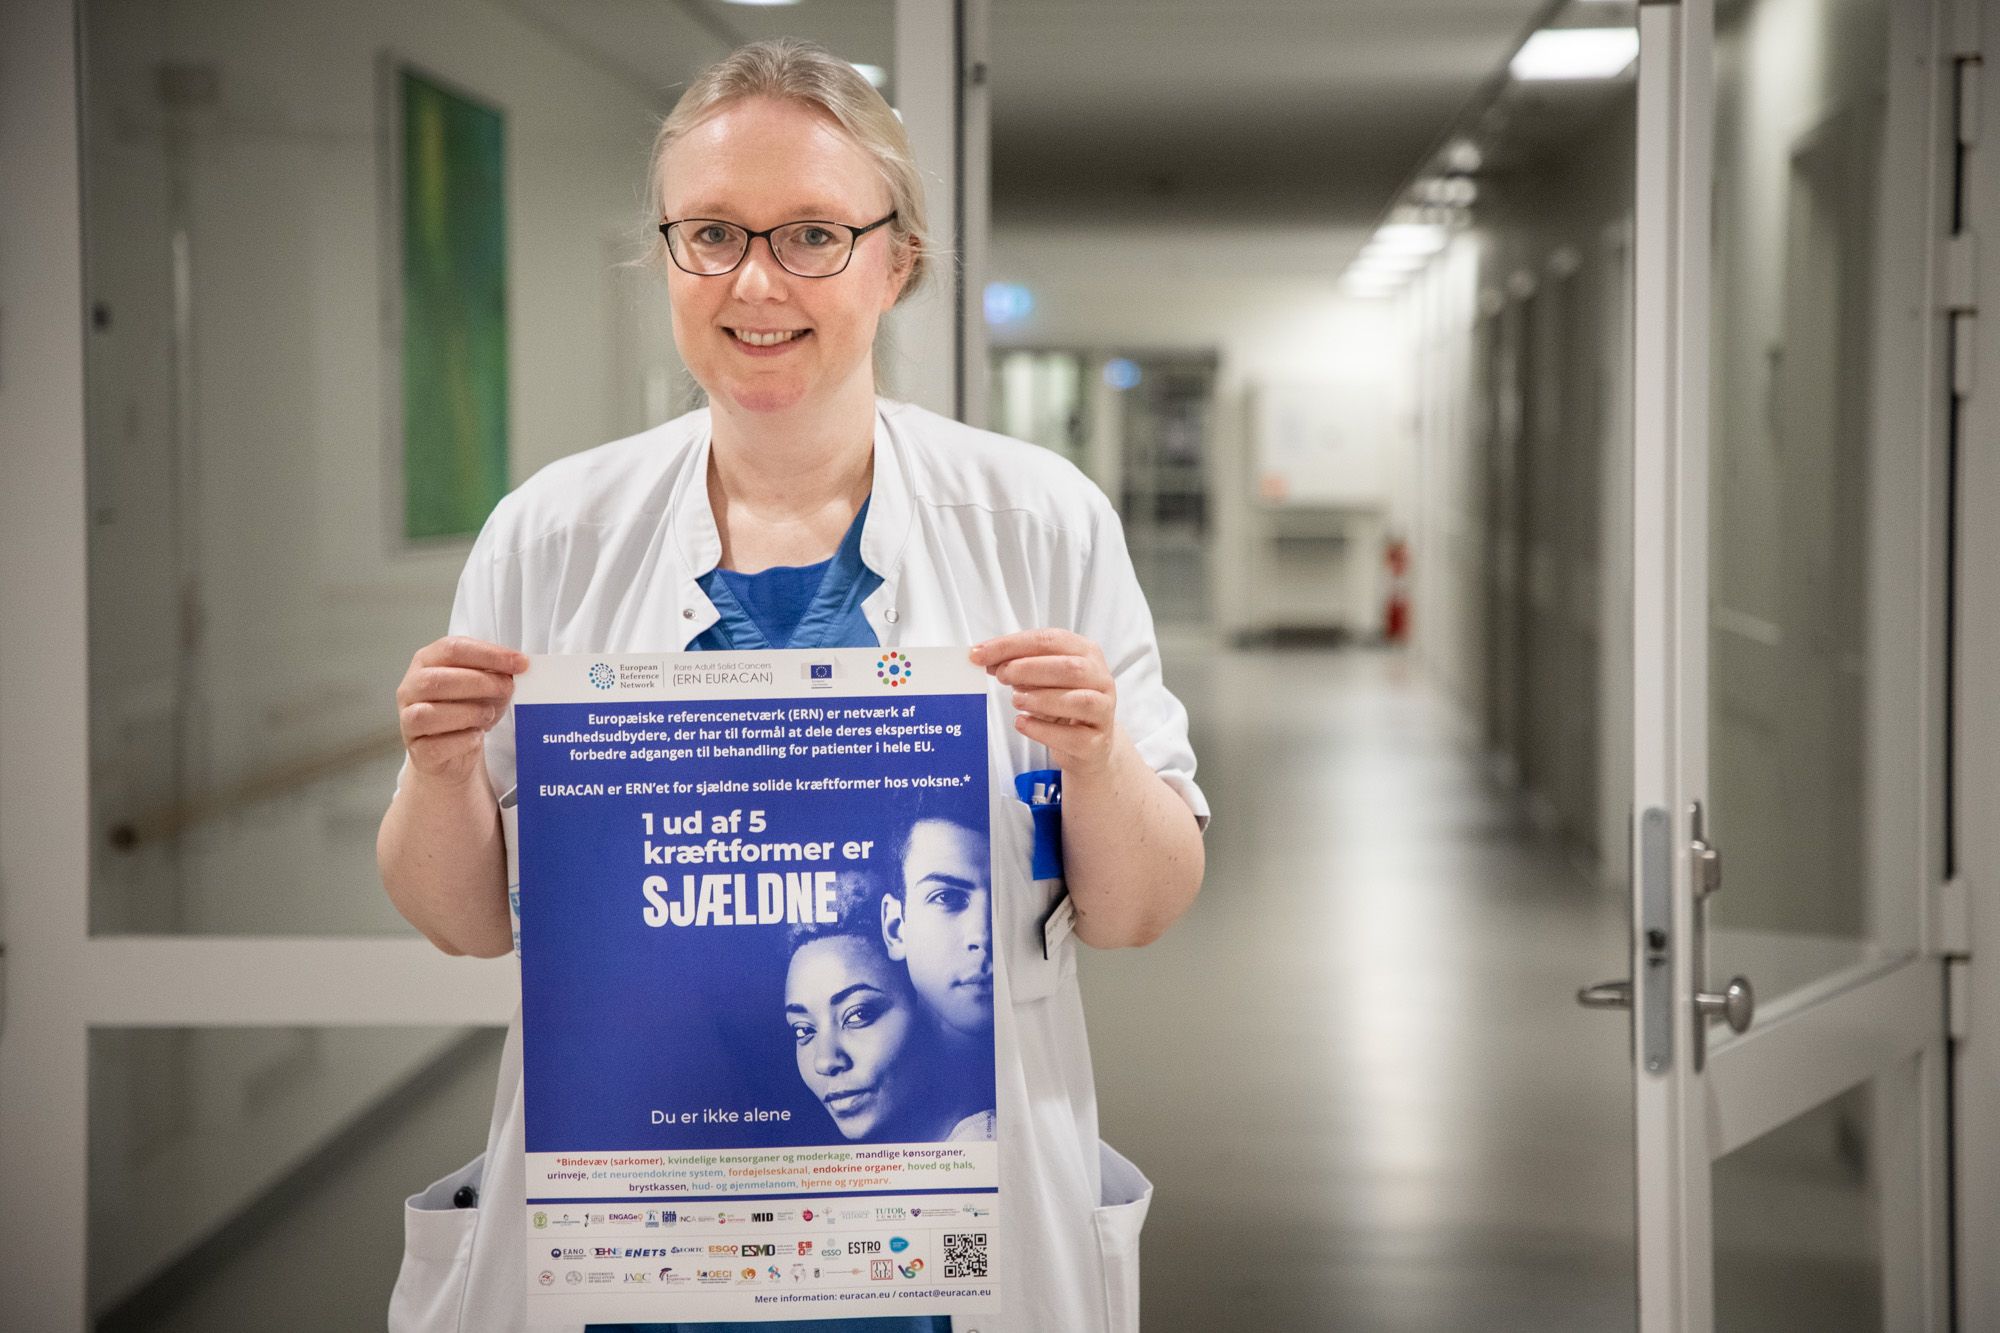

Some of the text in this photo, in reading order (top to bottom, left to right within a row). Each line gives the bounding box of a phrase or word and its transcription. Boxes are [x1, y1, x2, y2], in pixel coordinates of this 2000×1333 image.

[672, 672, 772, 686] (ERN EURACAN)
[588, 705, 915, 726] Europæiske referencenetværk (ERN) er netværk af
[542, 723, 961, 743] sundhedsudbydere, der har til formål at dele deres ekspertise og
[570, 741, 934, 761] forbedre adgangen til behandling for patienter i hele EU.
[540, 784, 603, 796] EURACAN
[607, 786, 622, 794] er
[672, 781, 693, 793] for
[696, 780, 749, 795] sjældne
[752, 779, 792, 791] solide
[796, 778, 881, 790] kræftformer
[884, 776, 908, 788] hos
[642, 809, 766, 835] 1 ud af 5
[644, 839, 873, 863] kræftformer er
[642, 872, 838, 928] SJÆLDNE
[651, 1108, 791, 1124] Du er ikke alene
[610, 1157, 665, 1166] (sarkomer),
[668, 1155, 717, 1166] kvindelige
[719, 1155, 780, 1164] kønsorganer
[782, 1154, 794, 1163] og
[796, 1152, 852, 1162] moderkage,
[856, 1150, 900, 1159] mandlige
[902, 1150, 965, 1158] kønsorganer,
[547, 1171, 588, 1181] urinveje,
[689, 1169, 726, 1178] system,
[728, 1167, 810, 1177] fordøjelseskanal,
[812, 1164, 862, 1174] endokrine
[864, 1164, 904, 1173] organer,
[629, 1183, 688, 1193] brystkassen,
[730, 1181, 798, 1190] øjenmelanom,
[802, 1180, 832, 1188] hjerne
[849, 1178, 891, 1187] rygmarv.
[751, 1213, 773, 1222] MID
[625, 1248, 667, 1258] ENETS
[742, 1244, 775, 1256] ESMO
[848, 1241, 881, 1254] ESTRO
